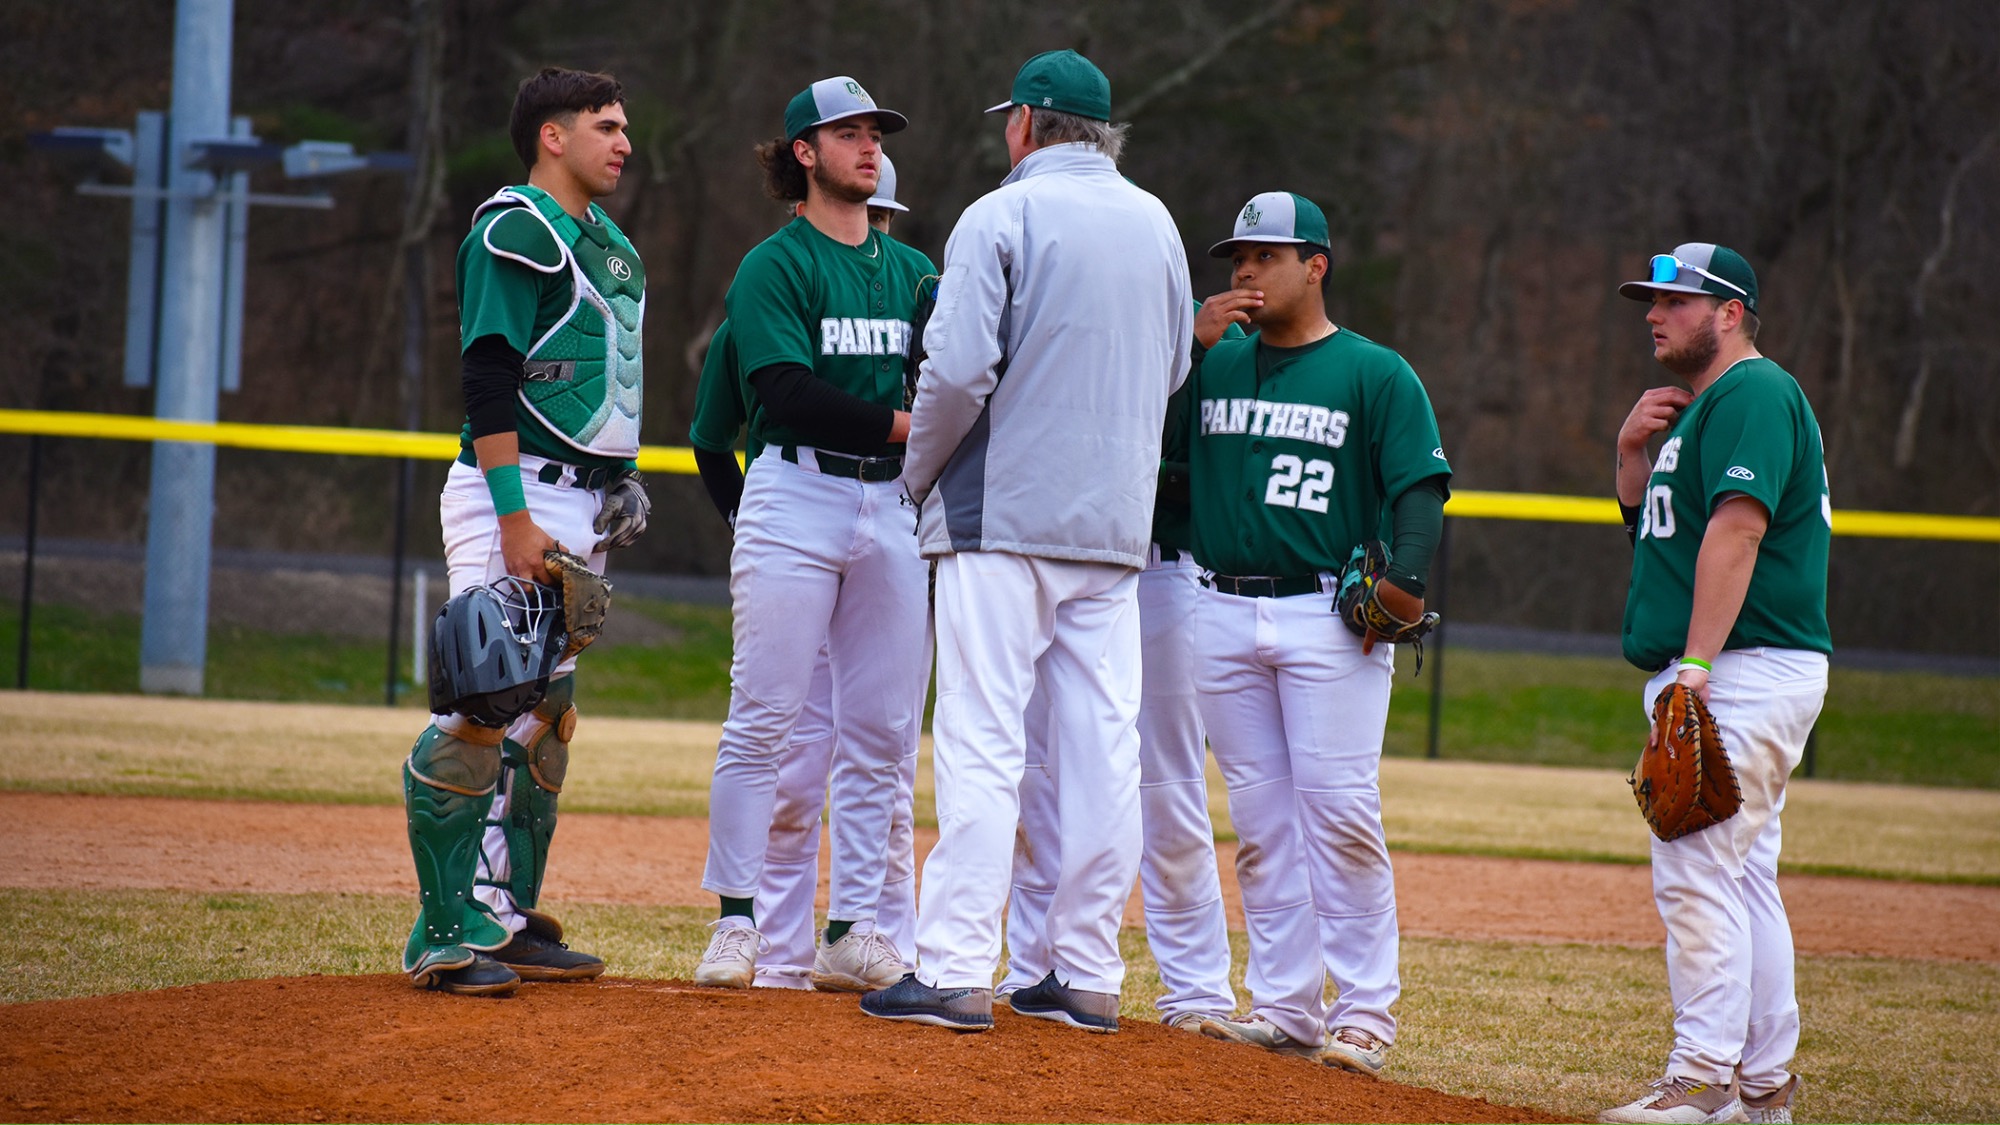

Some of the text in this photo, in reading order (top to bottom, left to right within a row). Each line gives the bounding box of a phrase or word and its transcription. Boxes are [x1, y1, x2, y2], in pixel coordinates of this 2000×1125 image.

[1200, 398, 1350, 448] PANTHERS
[1264, 453, 1335, 514] 22
[1640, 484, 1676, 540] 30
[939, 990, 969, 1003] Reebok
